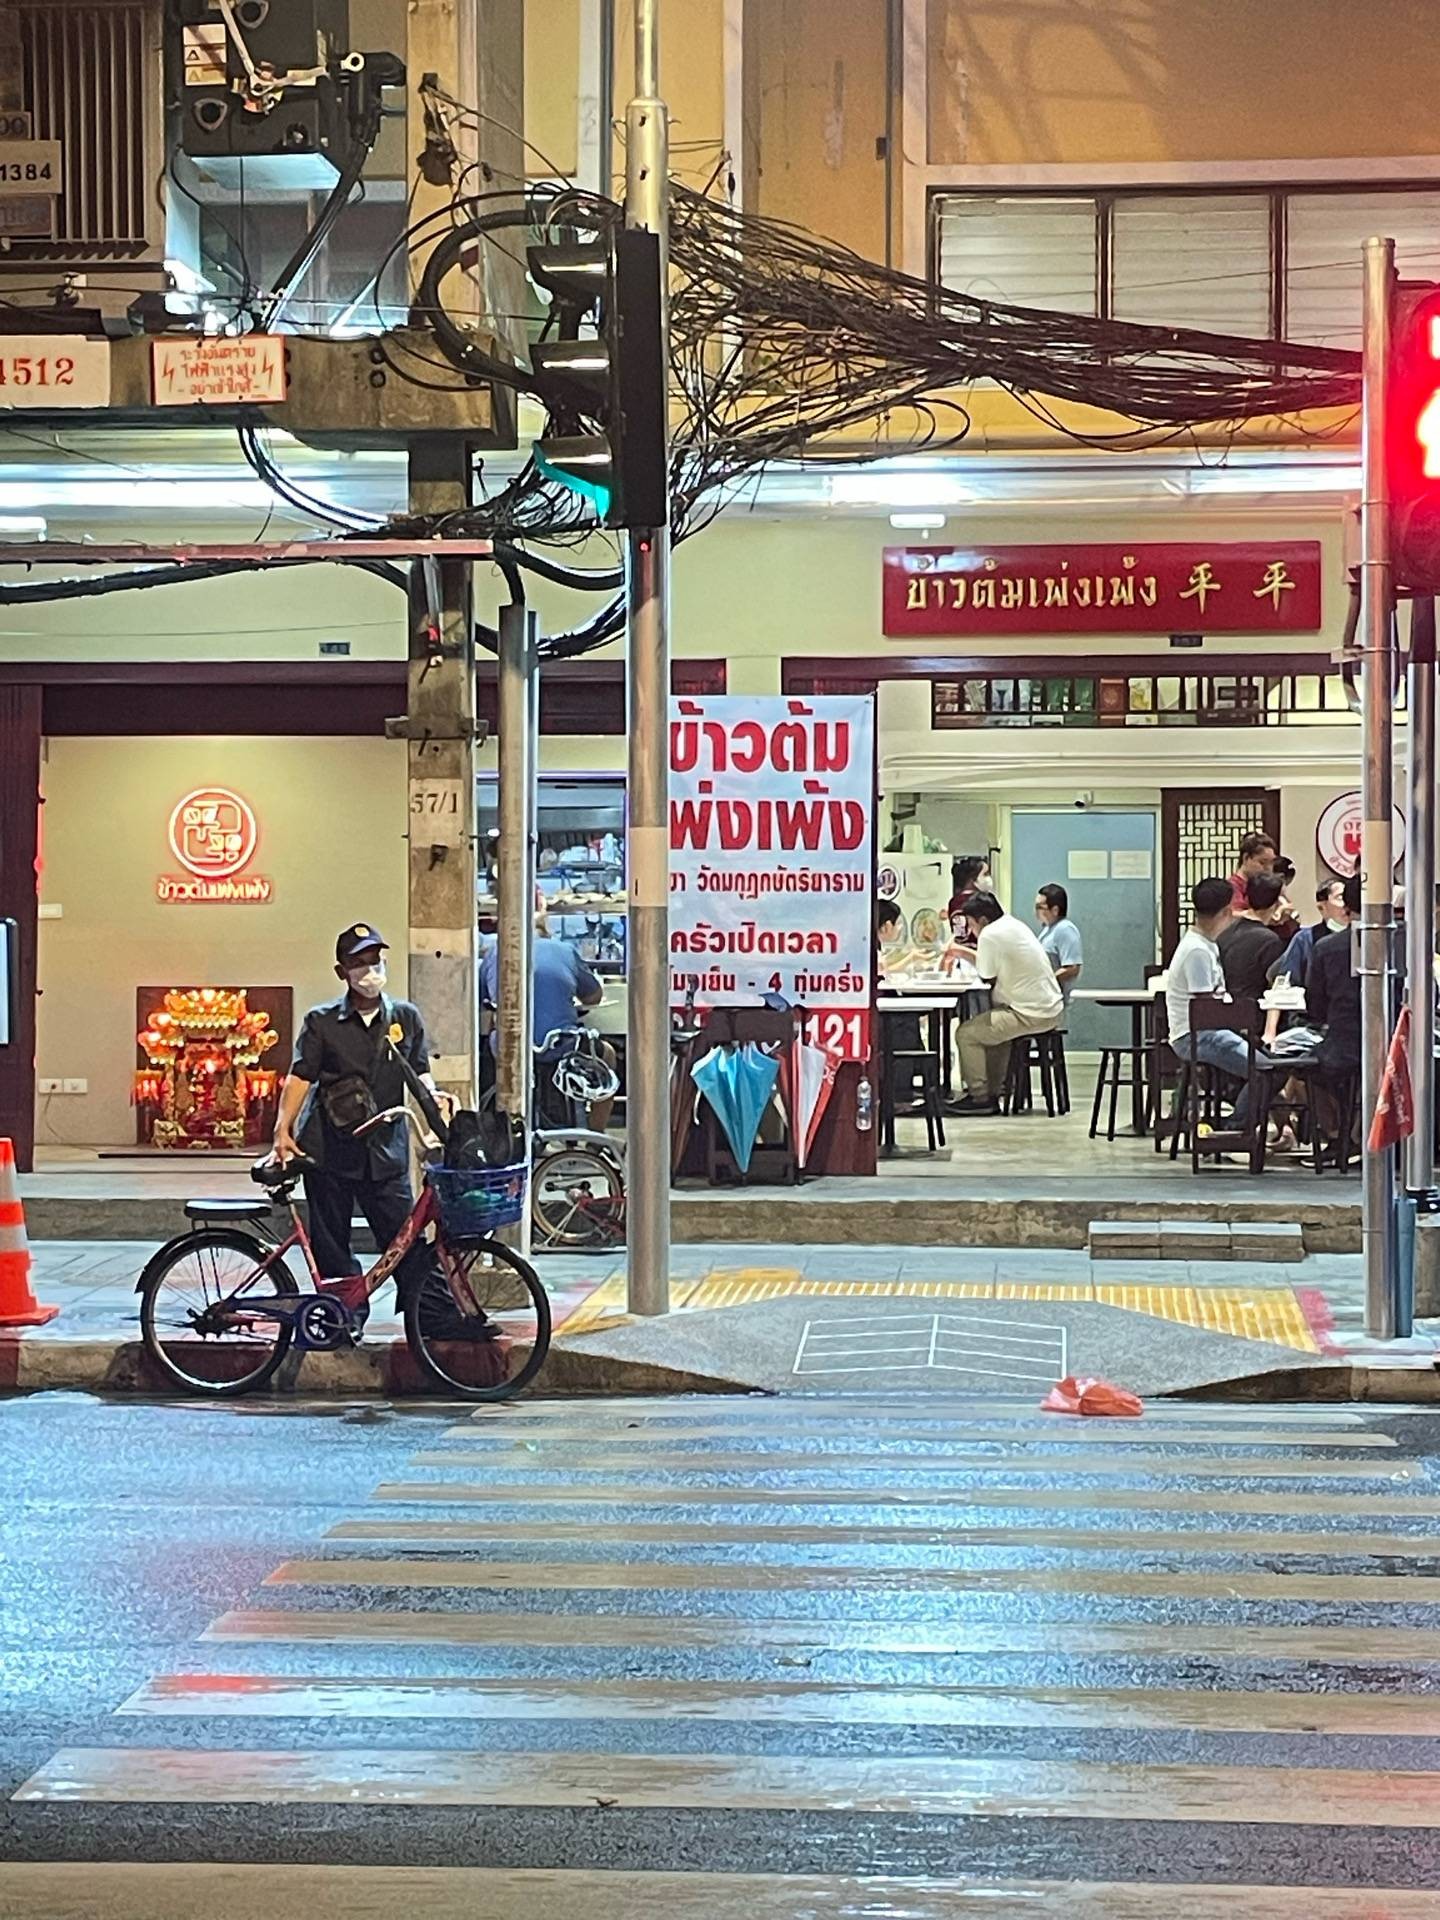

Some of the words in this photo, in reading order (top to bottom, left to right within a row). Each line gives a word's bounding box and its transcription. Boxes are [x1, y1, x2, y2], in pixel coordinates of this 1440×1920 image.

[1178, 561, 1222, 615] 平
[1252, 561, 1297, 613] 平
[670, 700, 849, 772] ข้าวต้ม
[410, 791, 457, 814] 57/1
[671, 922, 838, 954] ครัวเปิดเวลา
[768, 972, 783, 993] 4
[795, 963, 865, 1000] ทุ่มครึ่ง
